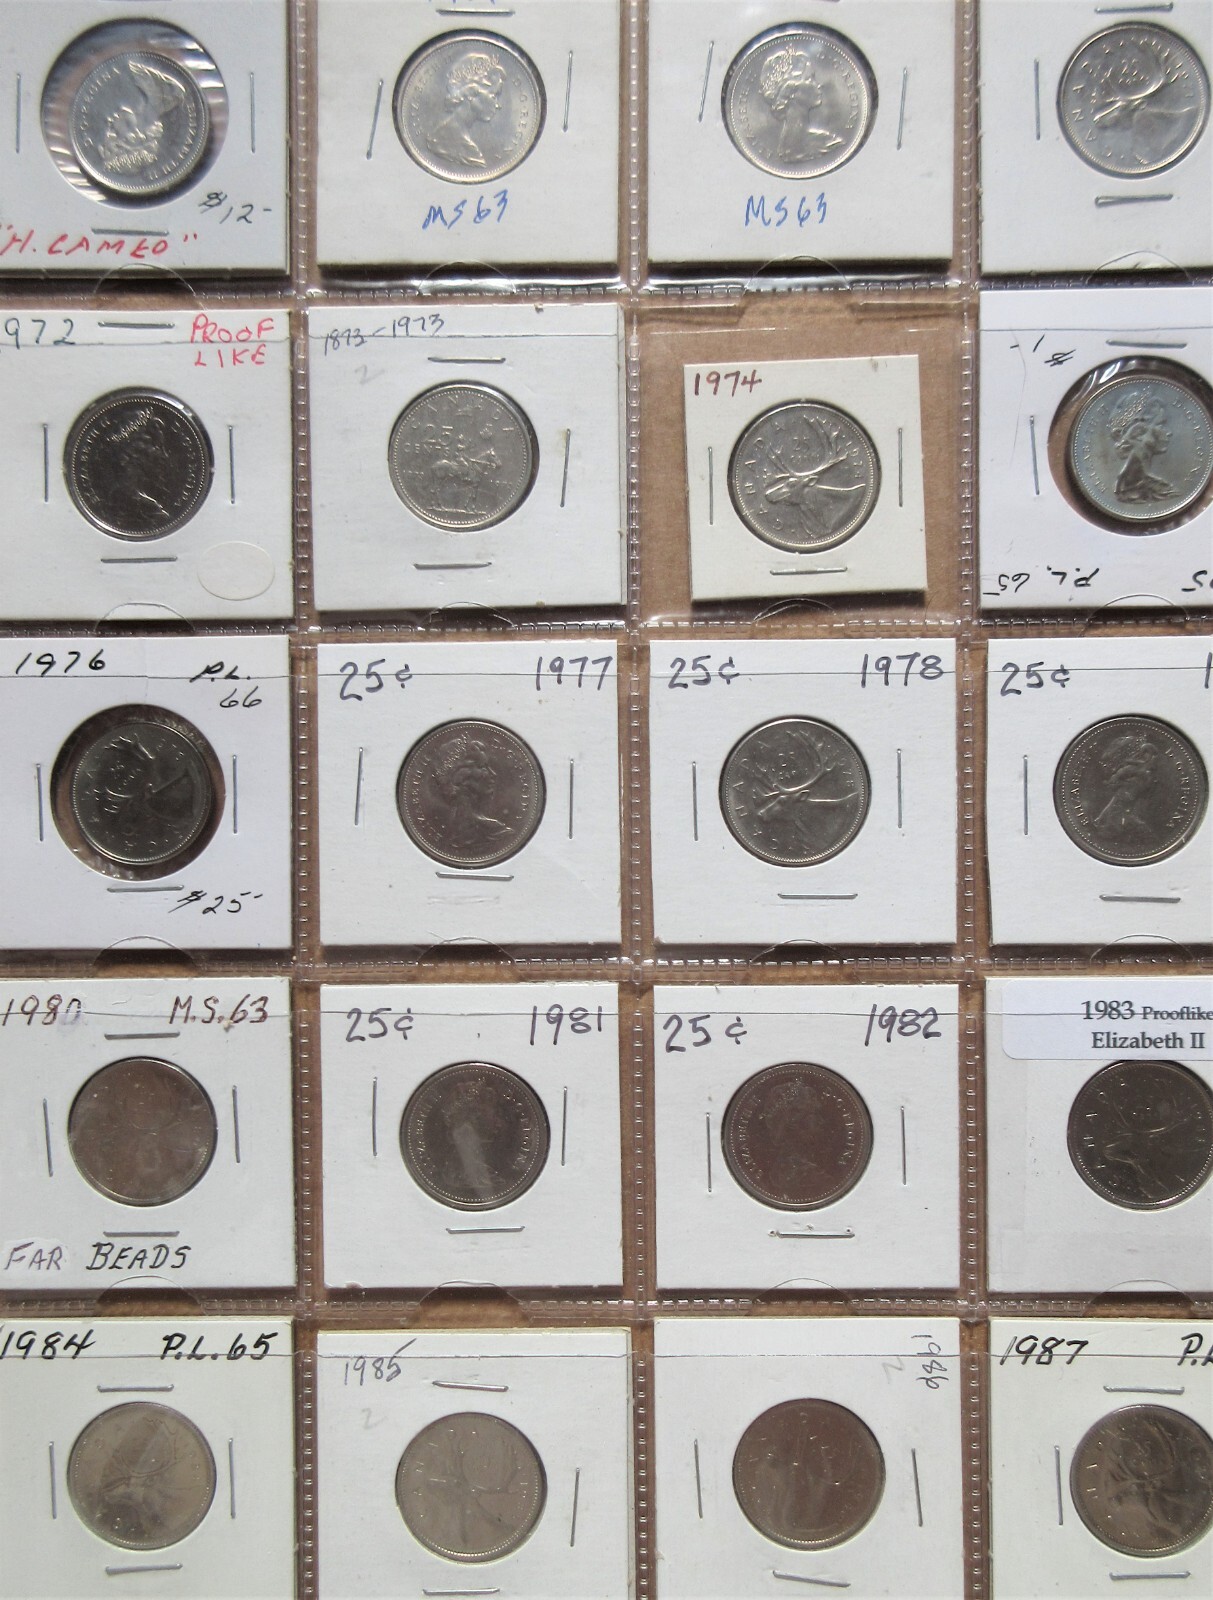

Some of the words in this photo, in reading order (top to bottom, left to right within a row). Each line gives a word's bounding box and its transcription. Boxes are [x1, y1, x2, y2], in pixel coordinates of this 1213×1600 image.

[0, 318, 76, 350] 972
[190, 313, 274, 343] PROOF
[194, 343, 267, 368] LIKE
[694, 369, 762, 397] 1974
[15, 648, 106, 677] 1976
[536, 656, 613, 692] 1977
[861, 652, 944, 689] 1978
[219, 686, 262, 708] 66
[530, 1003, 603, 1047] 1981
[864, 1003, 943, 1048] 1982
[1081, 1000, 1135, 1021] 1983
[1091, 1031, 1185, 1050] Elizabeth
[1189, 1031, 1206, 1049] II
[3, 1242, 62, 1271] FAR
[86, 1245, 191, 1271] BEADS
[0, 1329, 96, 1361] 1984
[1000, 1335, 1088, 1366] 1987
[344, 1337, 417, 1387] 1985
